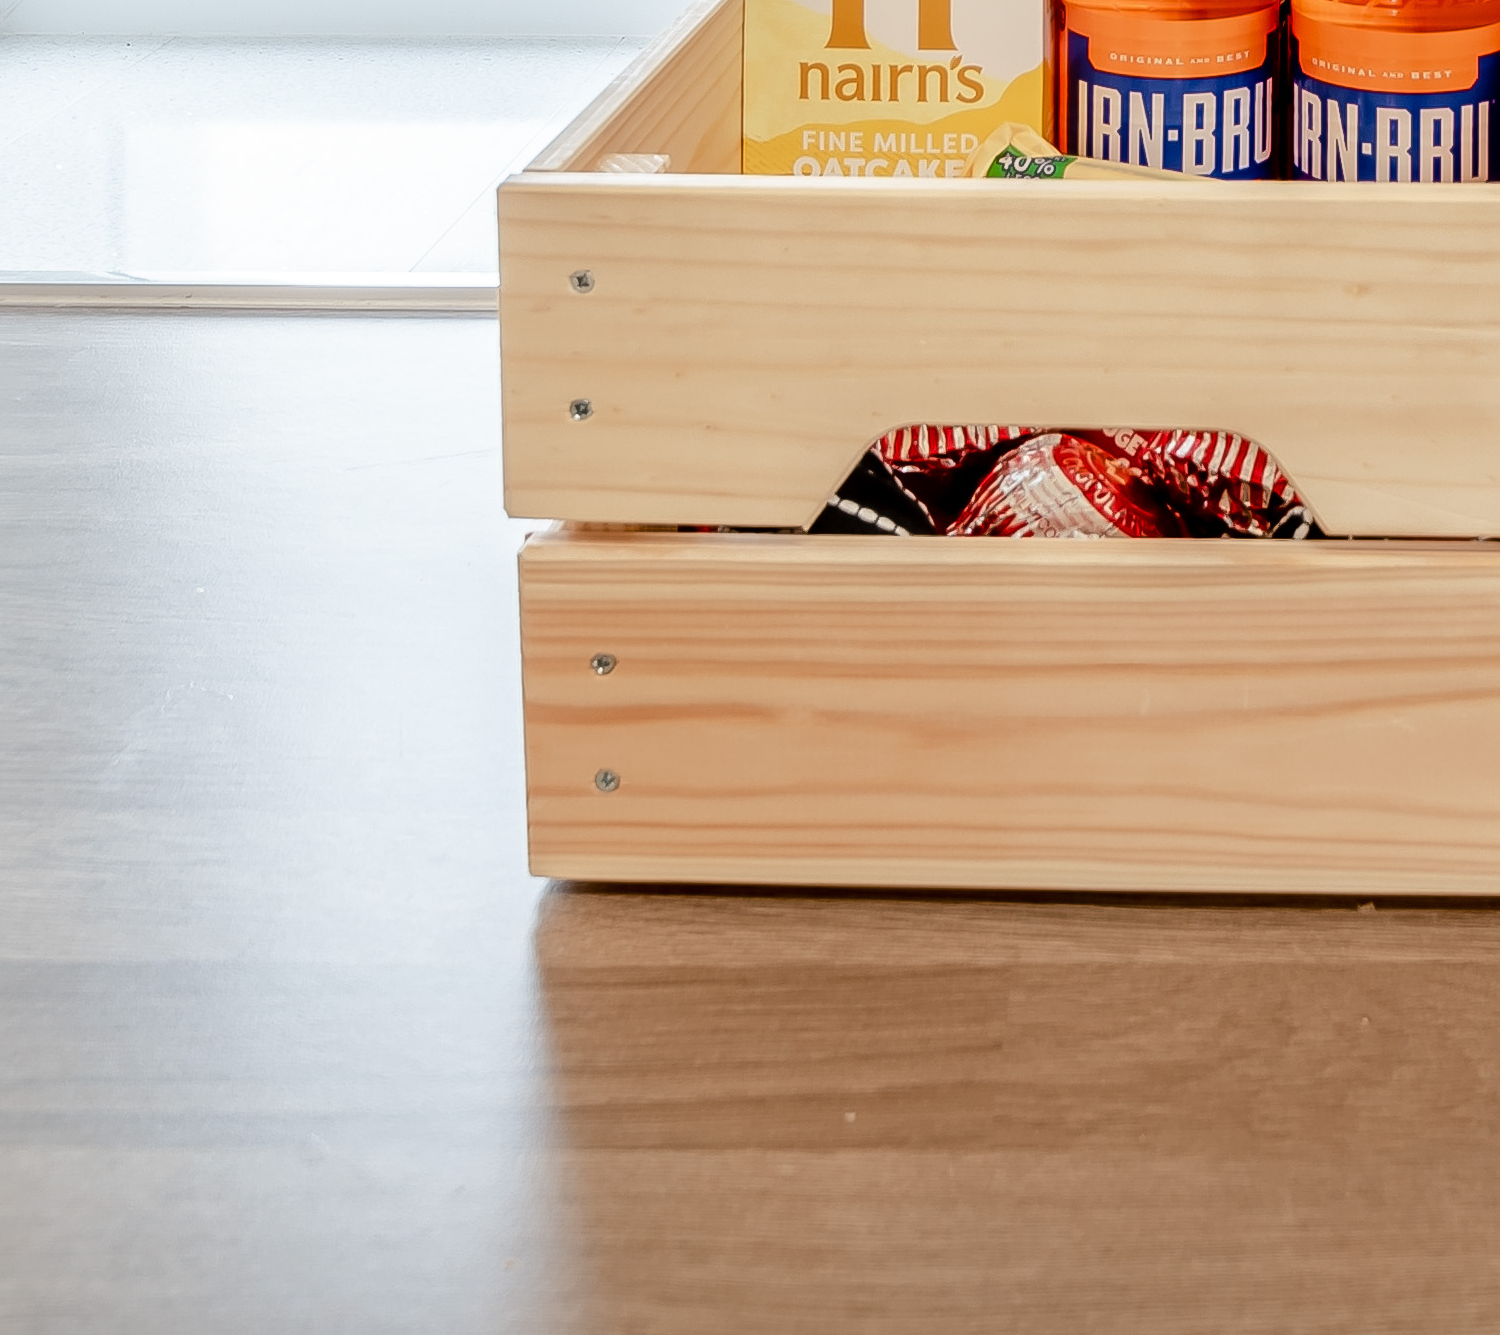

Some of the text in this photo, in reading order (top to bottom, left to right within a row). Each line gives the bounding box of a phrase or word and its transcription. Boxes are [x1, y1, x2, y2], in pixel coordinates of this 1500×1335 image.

[1109, 52, 1184, 65] ORIGINAL
[1216, 50, 1250, 63] BEST
[1311, 57, 1376, 78] ORIGINAL
[1411, 70, 1452, 79] BEST
[799, 54, 984, 103] nairn's
[802, 130, 979, 155] FINE MILLED
[998, 152, 1055, 175] 40%
